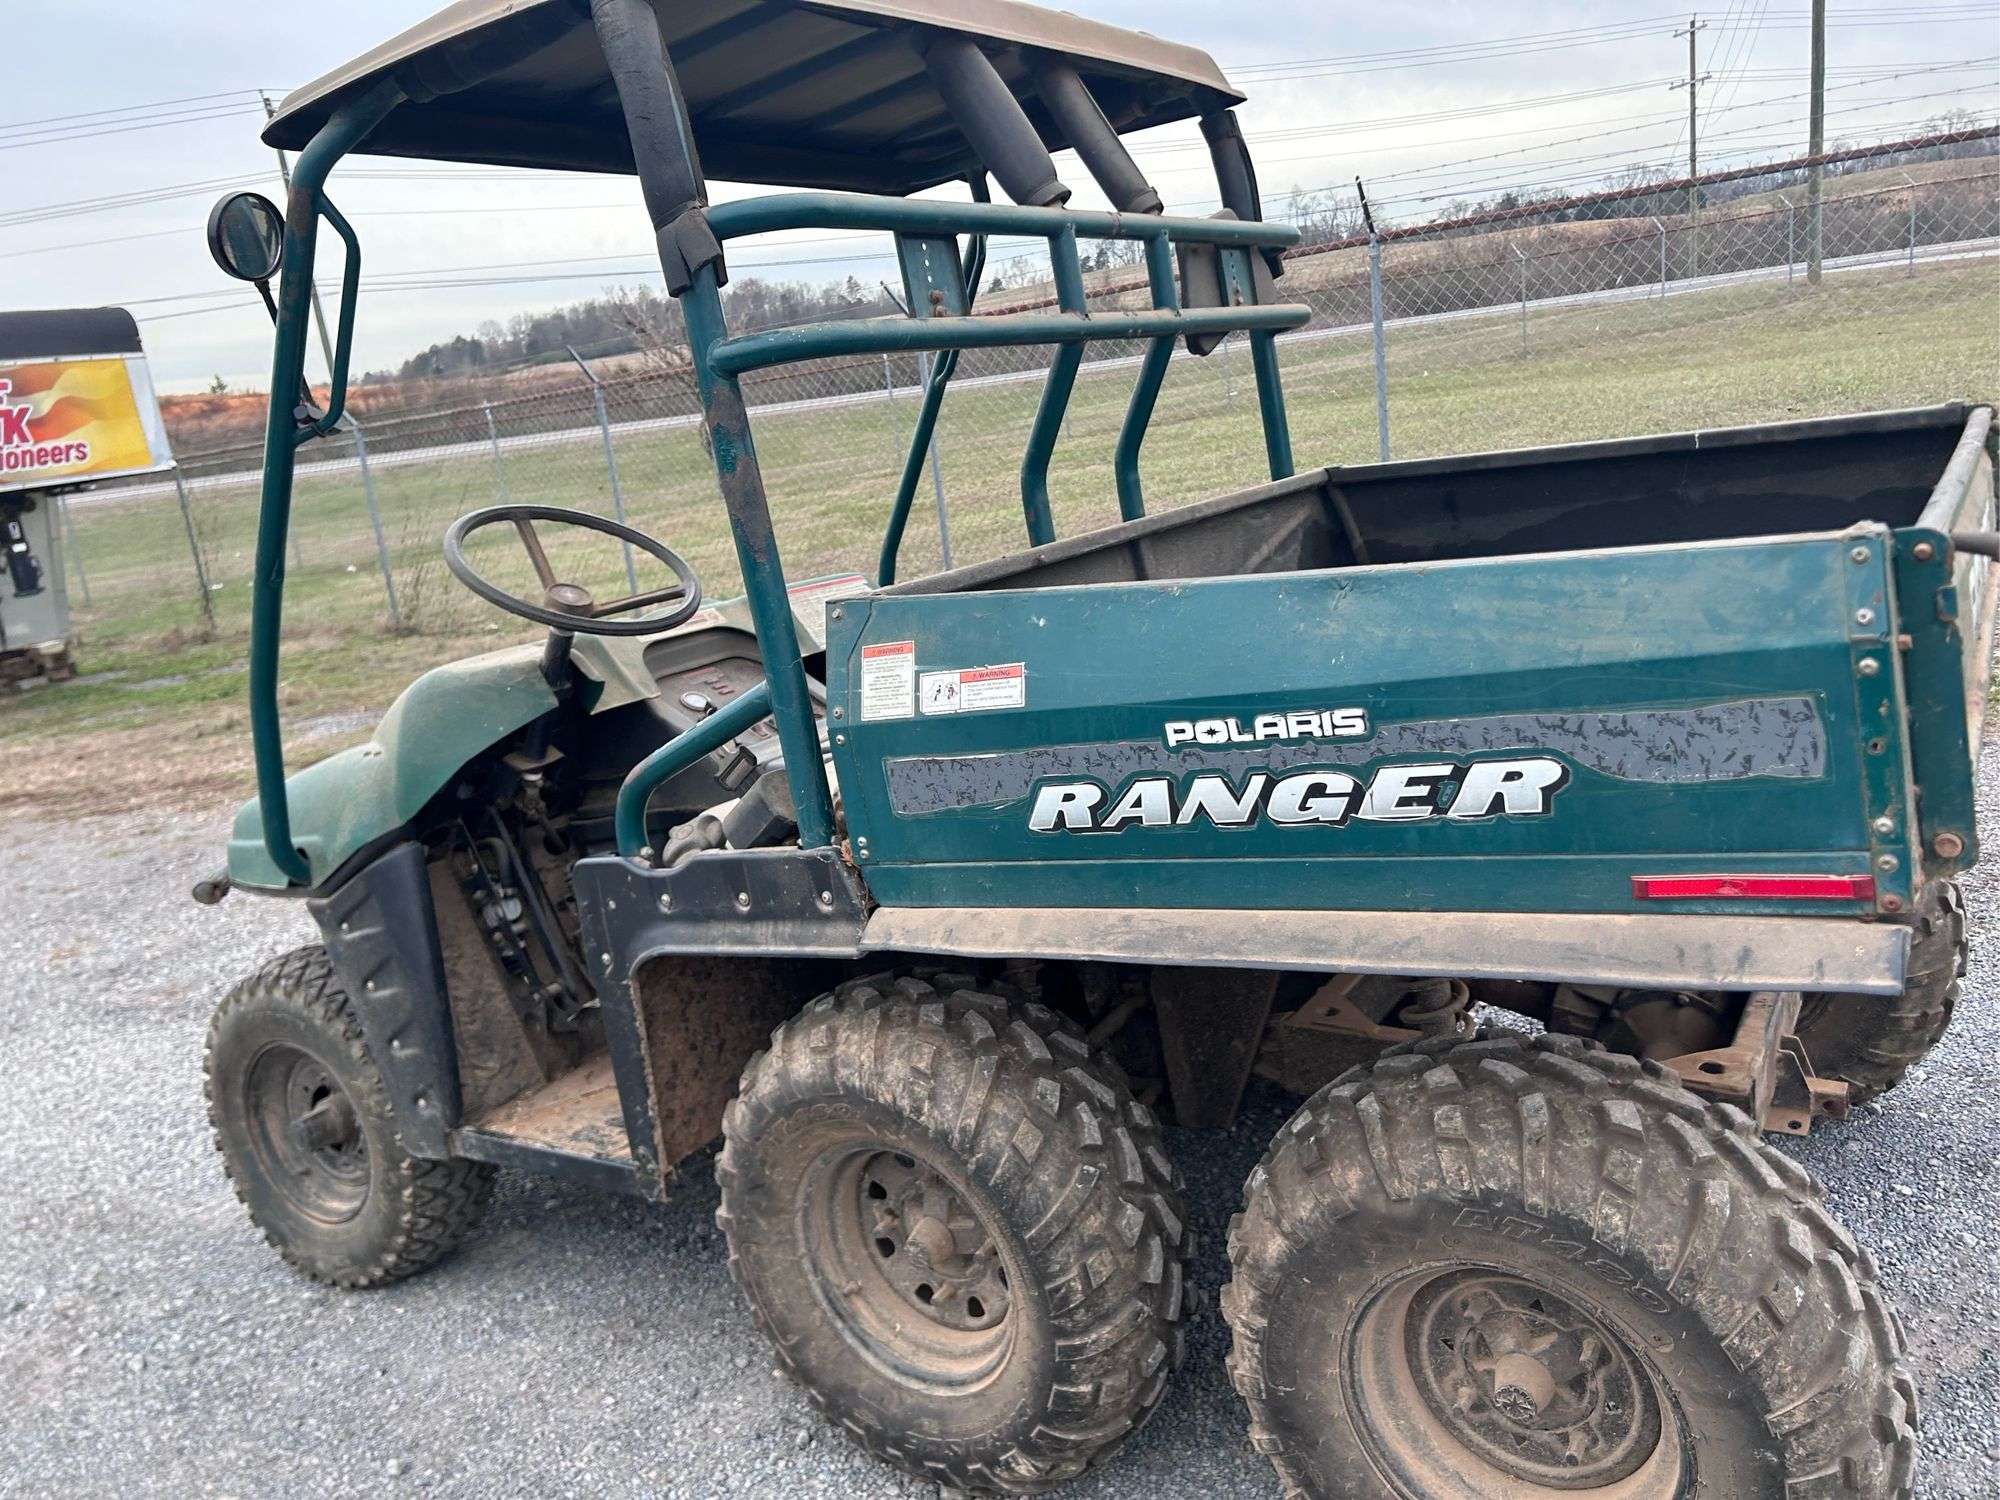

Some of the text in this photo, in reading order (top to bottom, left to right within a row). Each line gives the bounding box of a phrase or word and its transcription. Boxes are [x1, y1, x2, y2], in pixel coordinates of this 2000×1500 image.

[0, 406, 31, 445] K
[1165, 706, 1368, 748] POLARIS
[1028, 757, 1568, 831] RANGER
